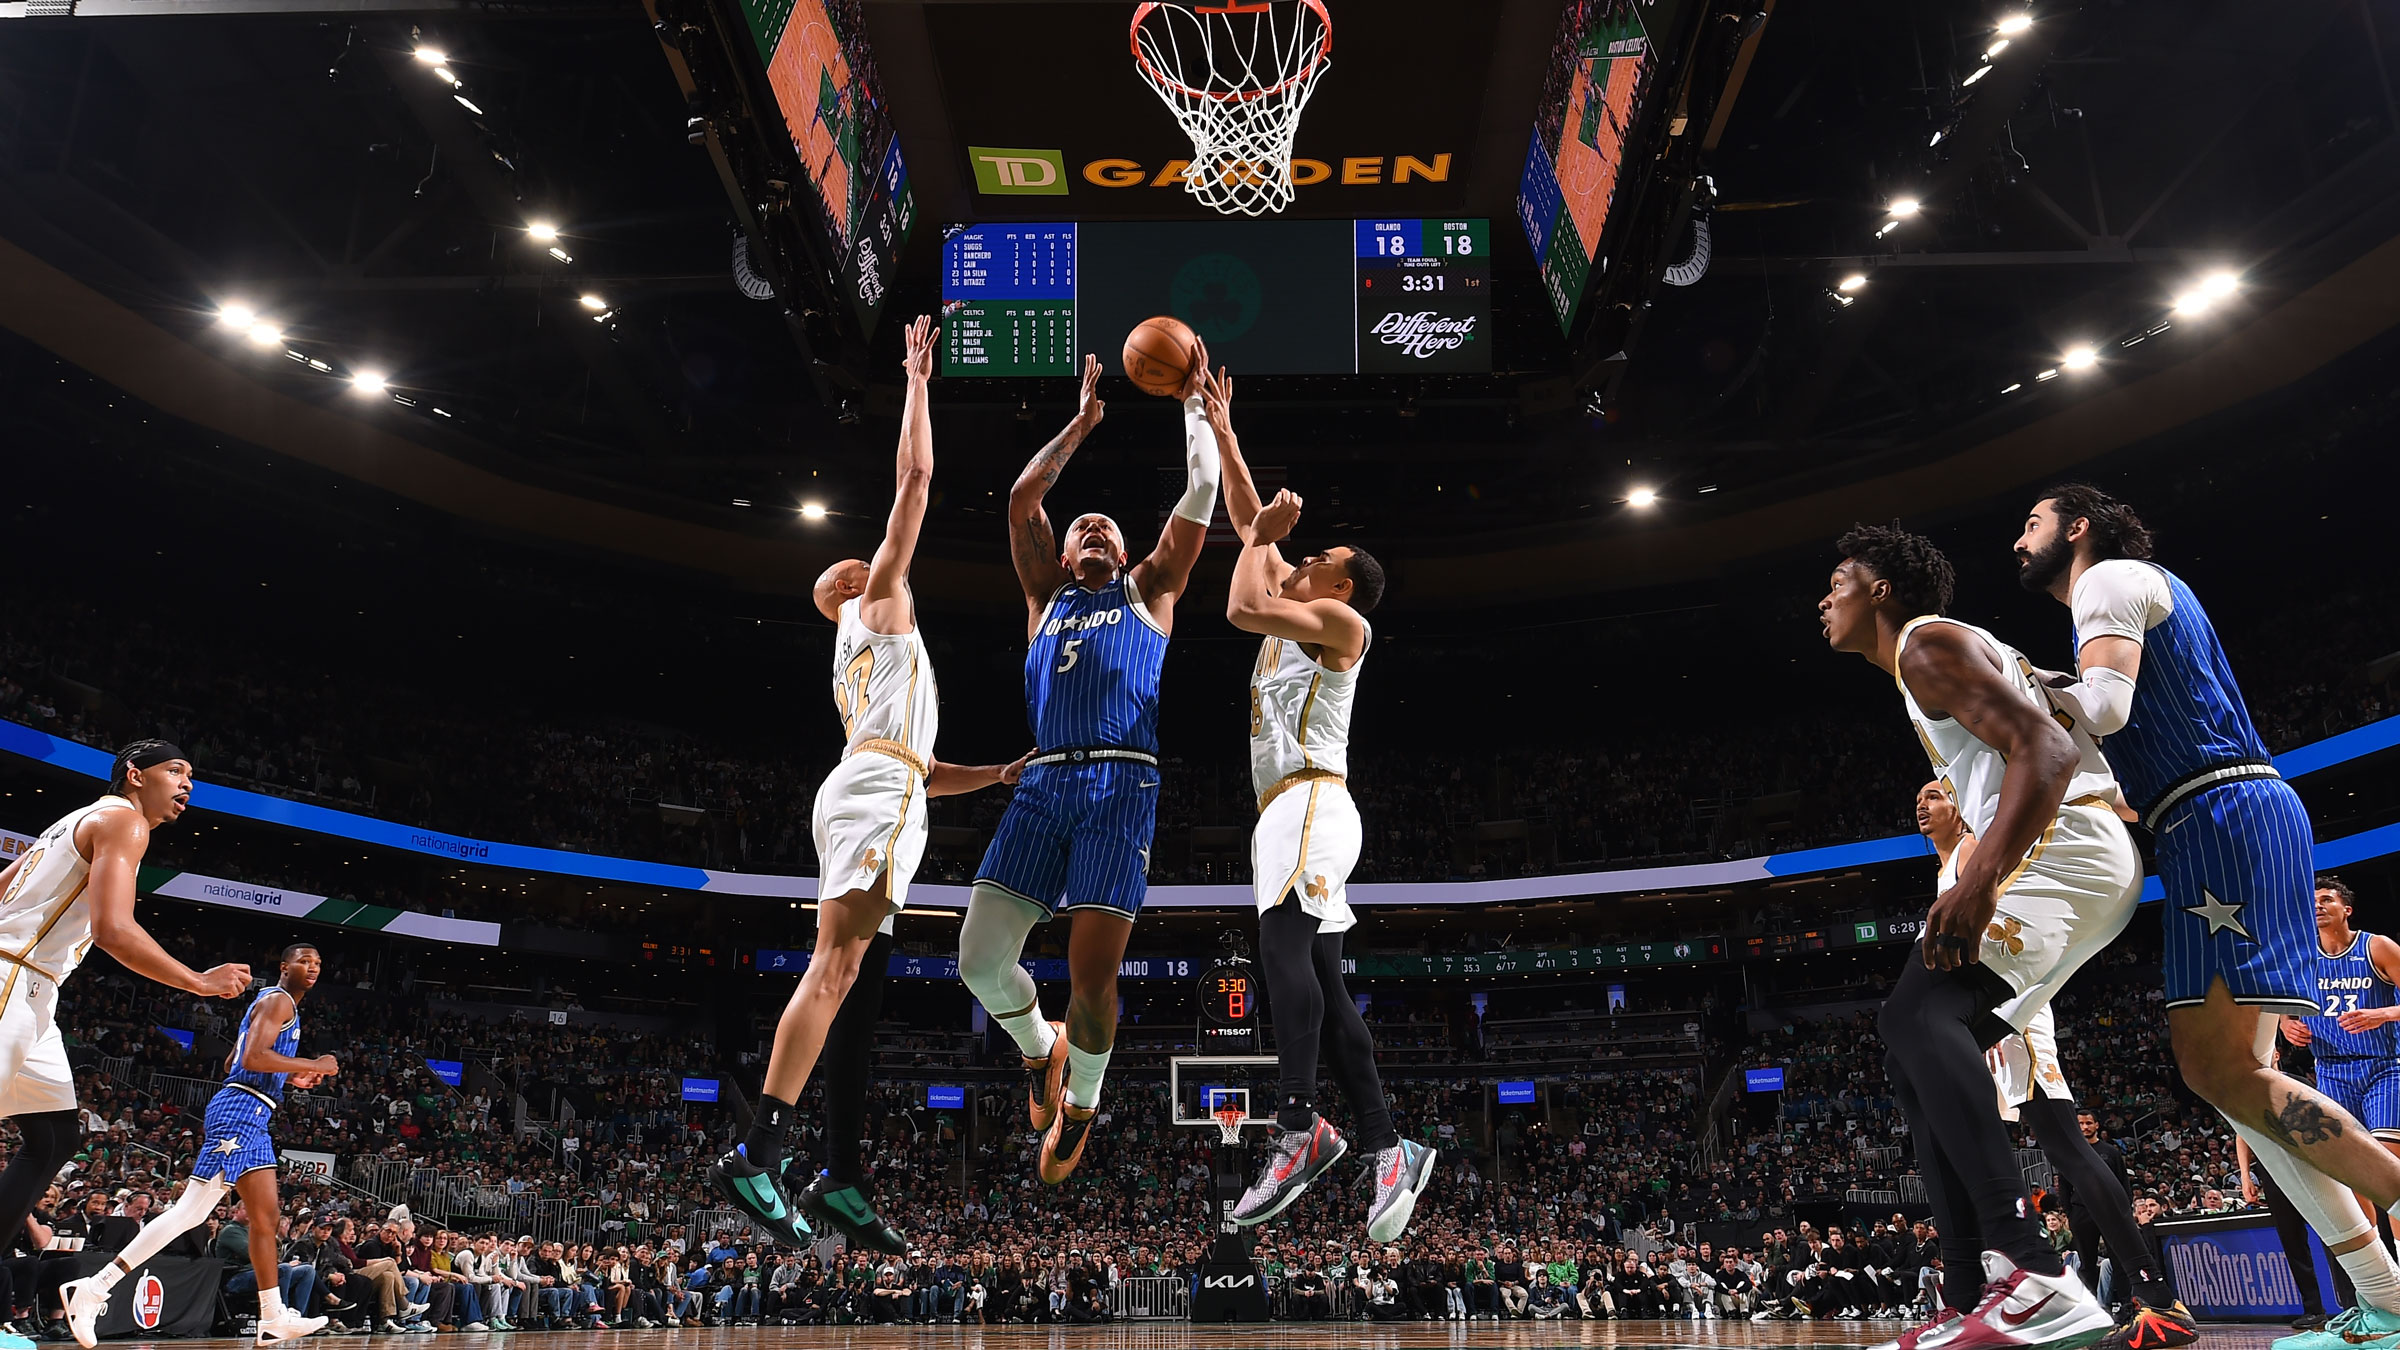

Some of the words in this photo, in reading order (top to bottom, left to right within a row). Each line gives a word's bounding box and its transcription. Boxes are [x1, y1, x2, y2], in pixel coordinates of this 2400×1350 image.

[979, 155, 1057, 187] TD
[1083, 152, 1452, 188] GARDEN
[1375, 223, 1401, 231] ORLANDO
[1444, 222, 1467, 231] BOSTON
[1376, 235, 1405, 255] 18
[1443, 235, 1472, 255] 18
[953, 252, 958, 260] 5
[963, 252, 992, 260] BANCHERO
[951, 278, 960, 286] 35
[1365, 279, 1372, 288] 8
[1402, 275, 1444, 291] 3:31
[1465, 278, 1480, 287] 1st
[962, 320, 980, 328] TONJE
[1370, 311, 1477, 344] Different
[951, 338, 958, 346] 27
[962, 338, 980, 346] WALSH
[1401, 332, 1464, 359] Here
[951, 356, 958, 364] 77
[962, 356, 989, 364] WILLIAMS
[1057, 639, 1083, 673] 5
[411, 832, 488, 858] nationalgrid
[203, 882, 282, 906] nationalgrid
[1857, 926, 1875, 939] TD
[1889, 922, 1915, 935] 6:28
[1572, 958, 1578, 966] 3
[1596, 956, 1602, 965] 3
[1620, 954, 1626, 963] 3
[1644, 953, 1650, 962] 9
[1167, 961, 1189, 976] 18
[1446, 964, 1452, 973] 7
[1464, 964, 1480, 973] 35.3
[1496, 962, 1516, 971] 6/17
[1536, 960, 1556, 968] 4/11
[905, 965, 921, 976] 3/8
[944, 966, 959, 977] 7/1
[1028, 968, 1034, 977] 2
[1427, 965, 1431, 973] 1
[1217, 979, 1246, 993] 3:30
[1229, 993, 1244, 1018] 8
[2324, 994, 2358, 1017] 23
[552, 1013, 564, 1024] 16
[1218, 1028, 1252, 1036] TISSOT
[684, 1087, 716, 1095] ticketmaster
[1223, 1200, 1234, 1210] GET
[1205, 1275, 1254, 1288] KIA
